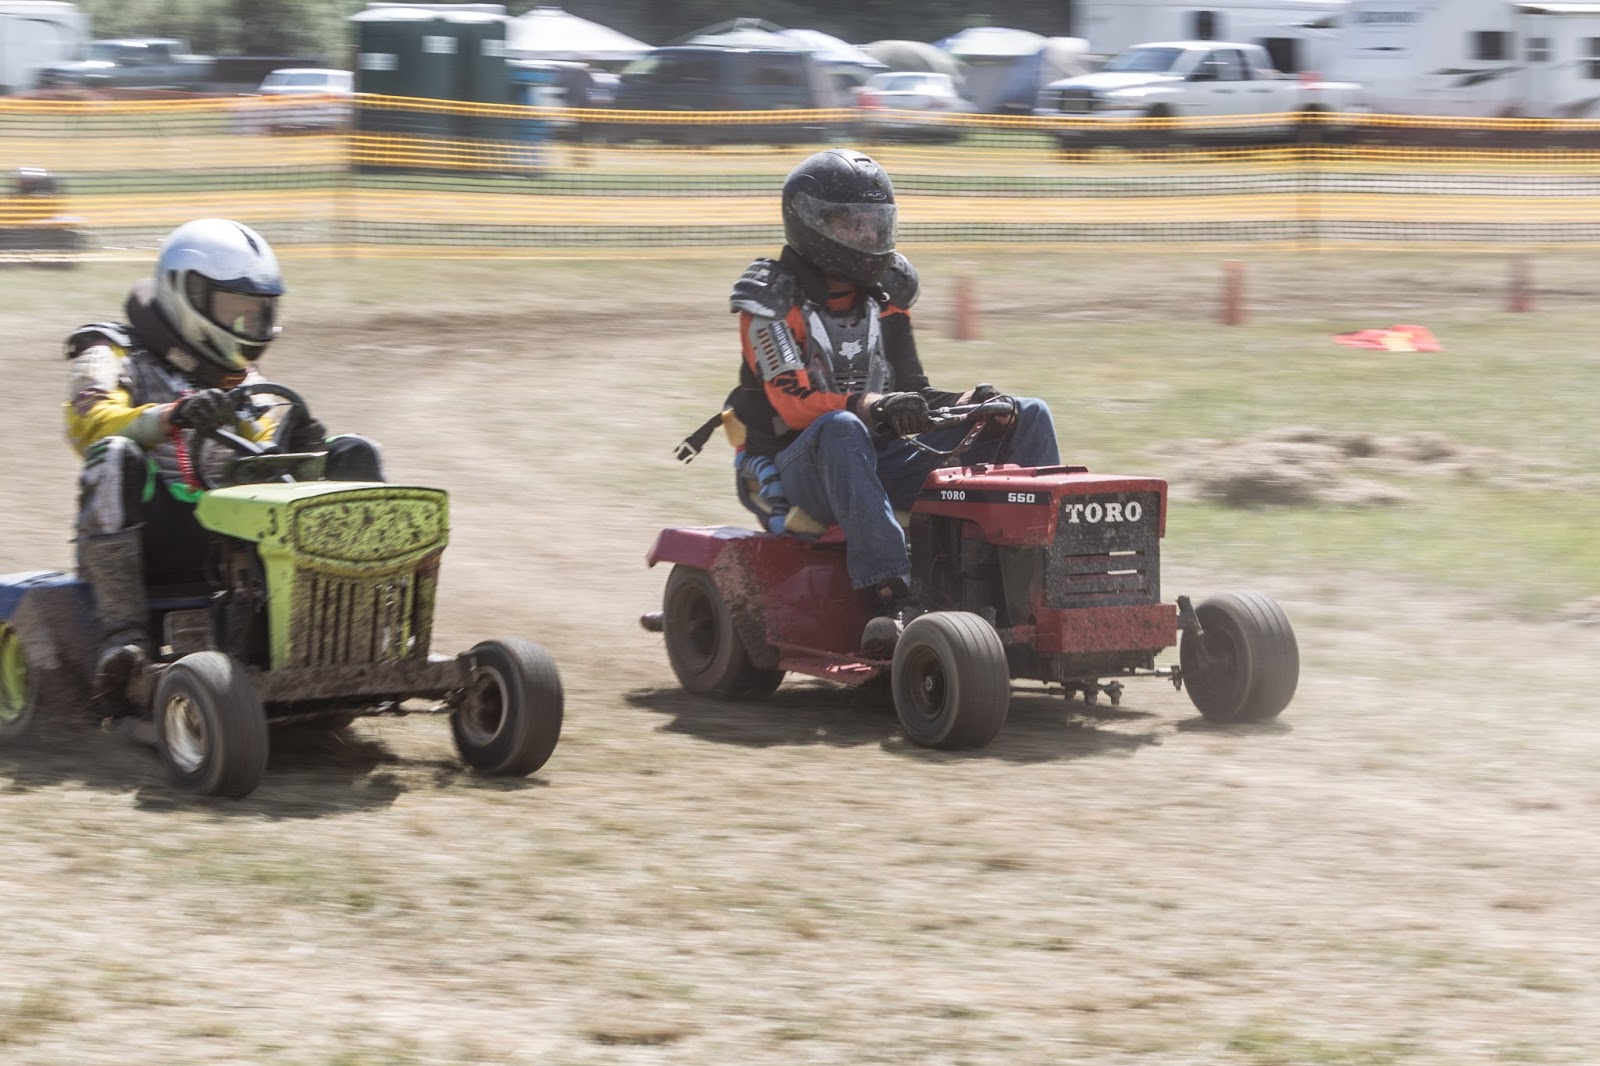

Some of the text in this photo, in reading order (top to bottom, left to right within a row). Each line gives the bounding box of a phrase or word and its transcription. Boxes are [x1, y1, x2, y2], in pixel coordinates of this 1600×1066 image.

[940, 490, 966, 501] TORO
[1007, 492, 1036, 503] 550
[1065, 501, 1142, 524] TORO
